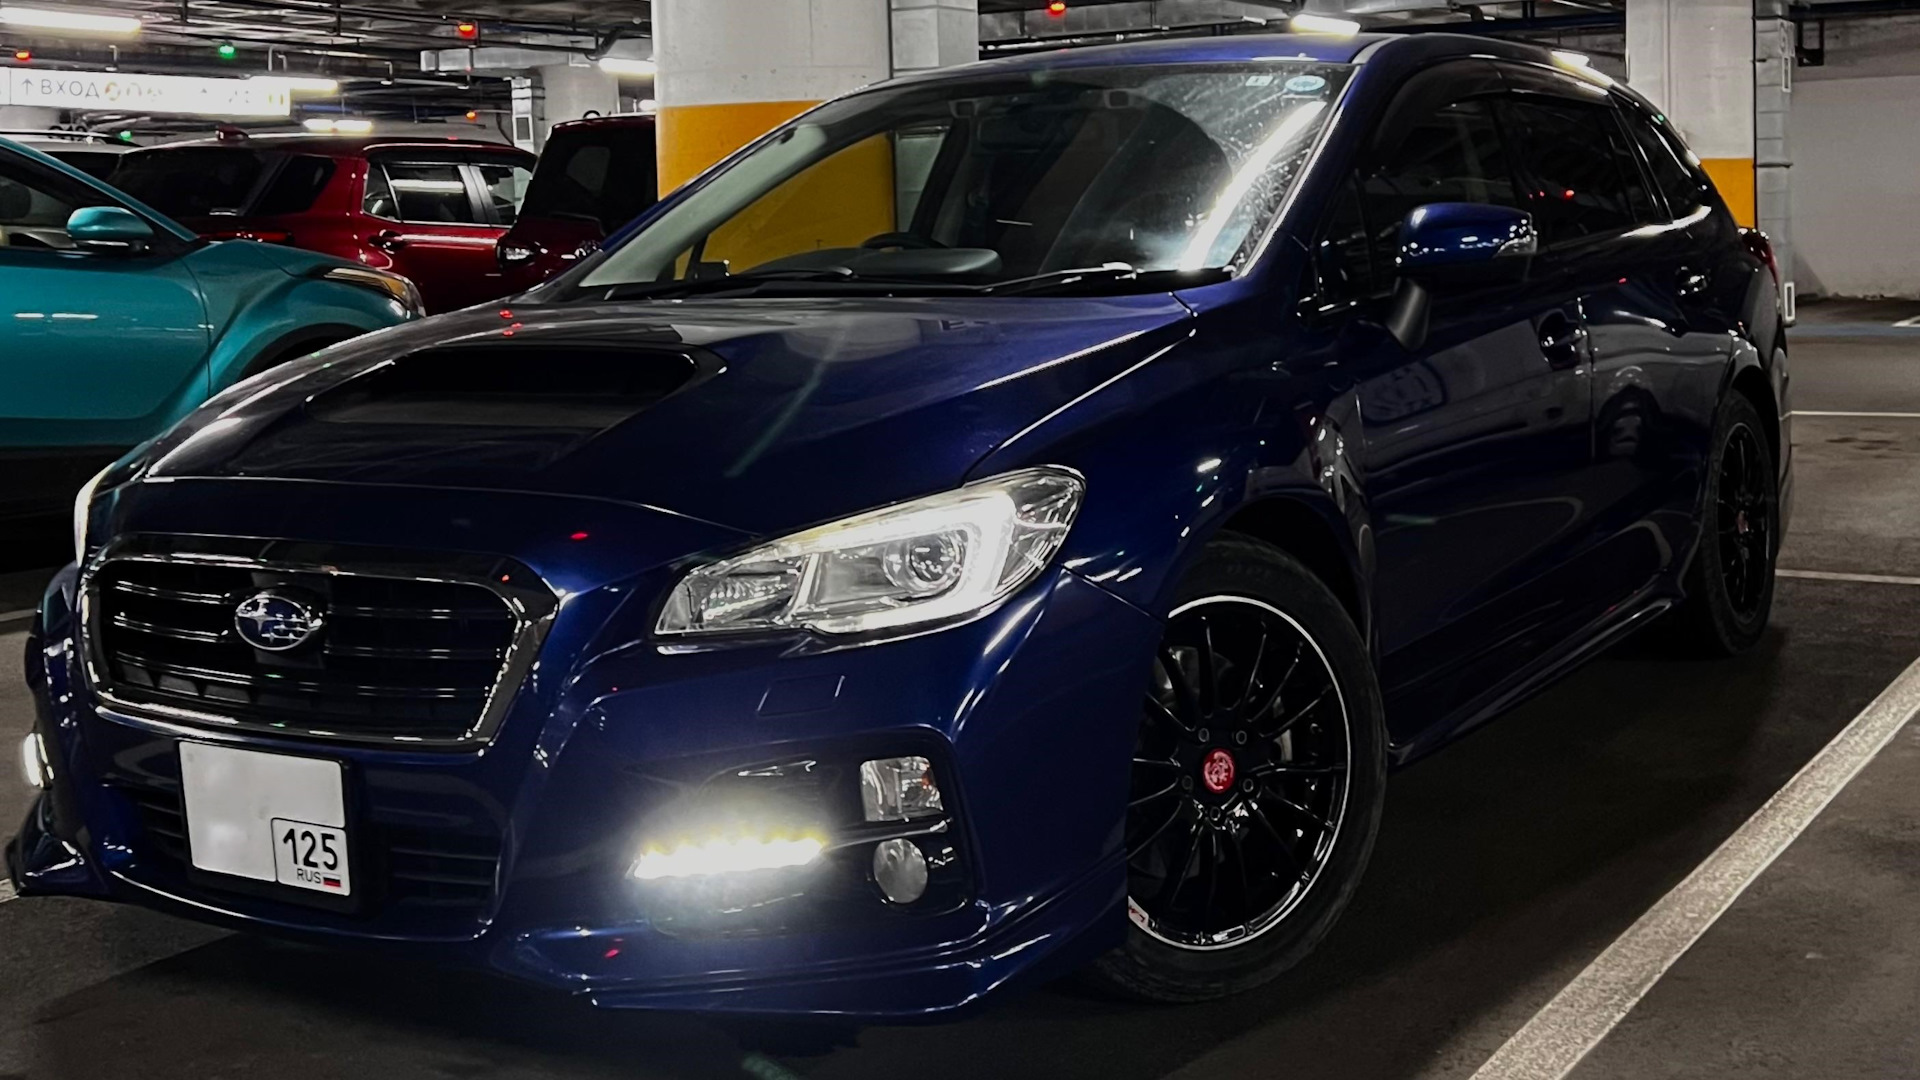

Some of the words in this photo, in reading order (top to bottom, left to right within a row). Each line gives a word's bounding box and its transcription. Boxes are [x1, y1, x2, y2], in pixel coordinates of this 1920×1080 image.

[40, 79, 100, 99] ВХОД
[283, 828, 338, 871] 125
[297, 868, 321, 884] RUS
